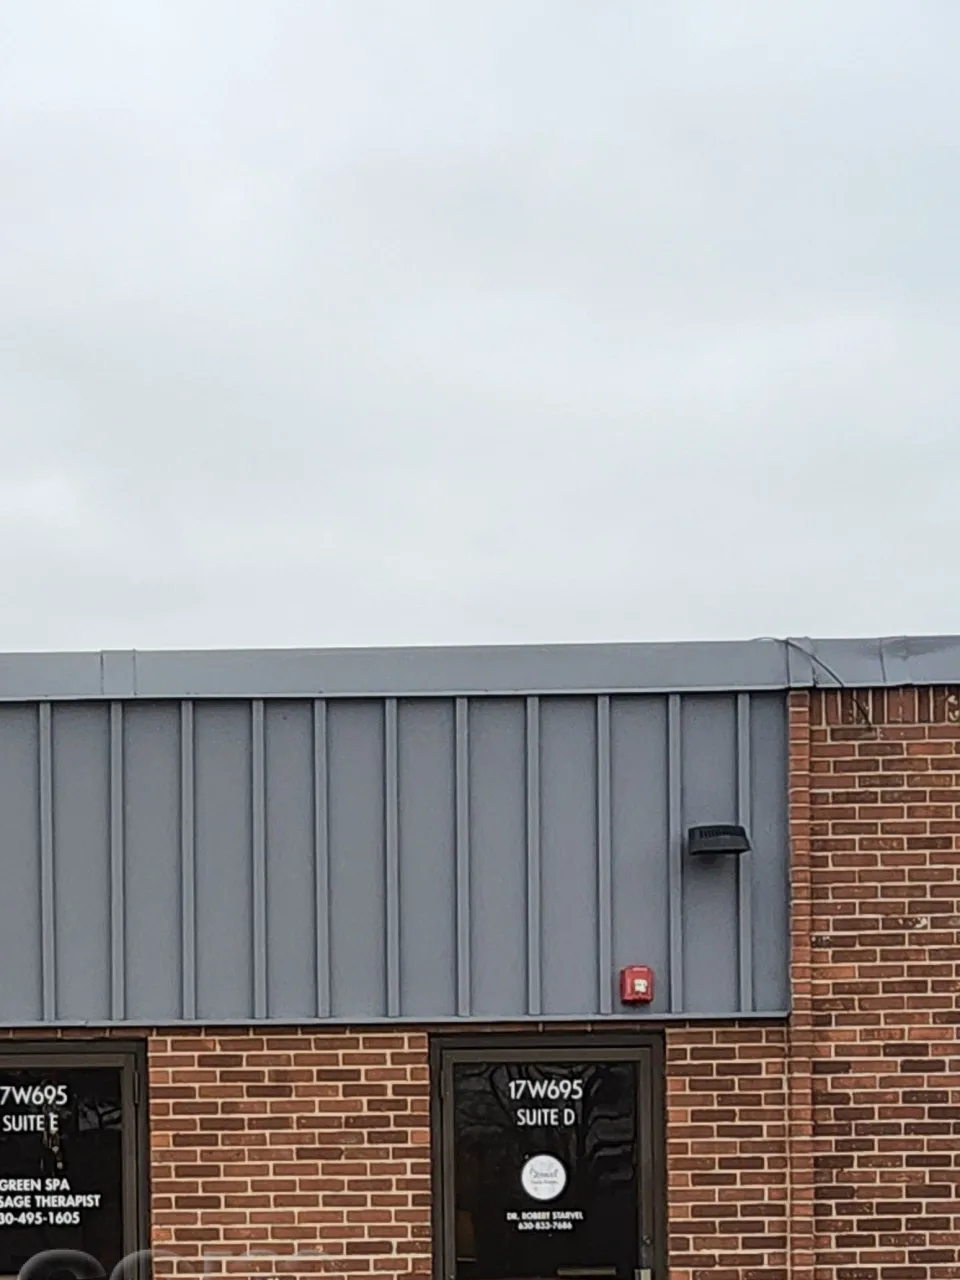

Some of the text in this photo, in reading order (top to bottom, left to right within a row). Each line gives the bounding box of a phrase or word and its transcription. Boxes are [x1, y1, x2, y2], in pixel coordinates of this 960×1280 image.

[508, 1080, 583, 1100] 17W695
[2, 1113, 59, 1132] SUITE E
[516, 1108, 576, 1126] SUITE D
[44, 1178, 71, 1192] SPA
[34, 1194, 101, 1209] THERAPIST
